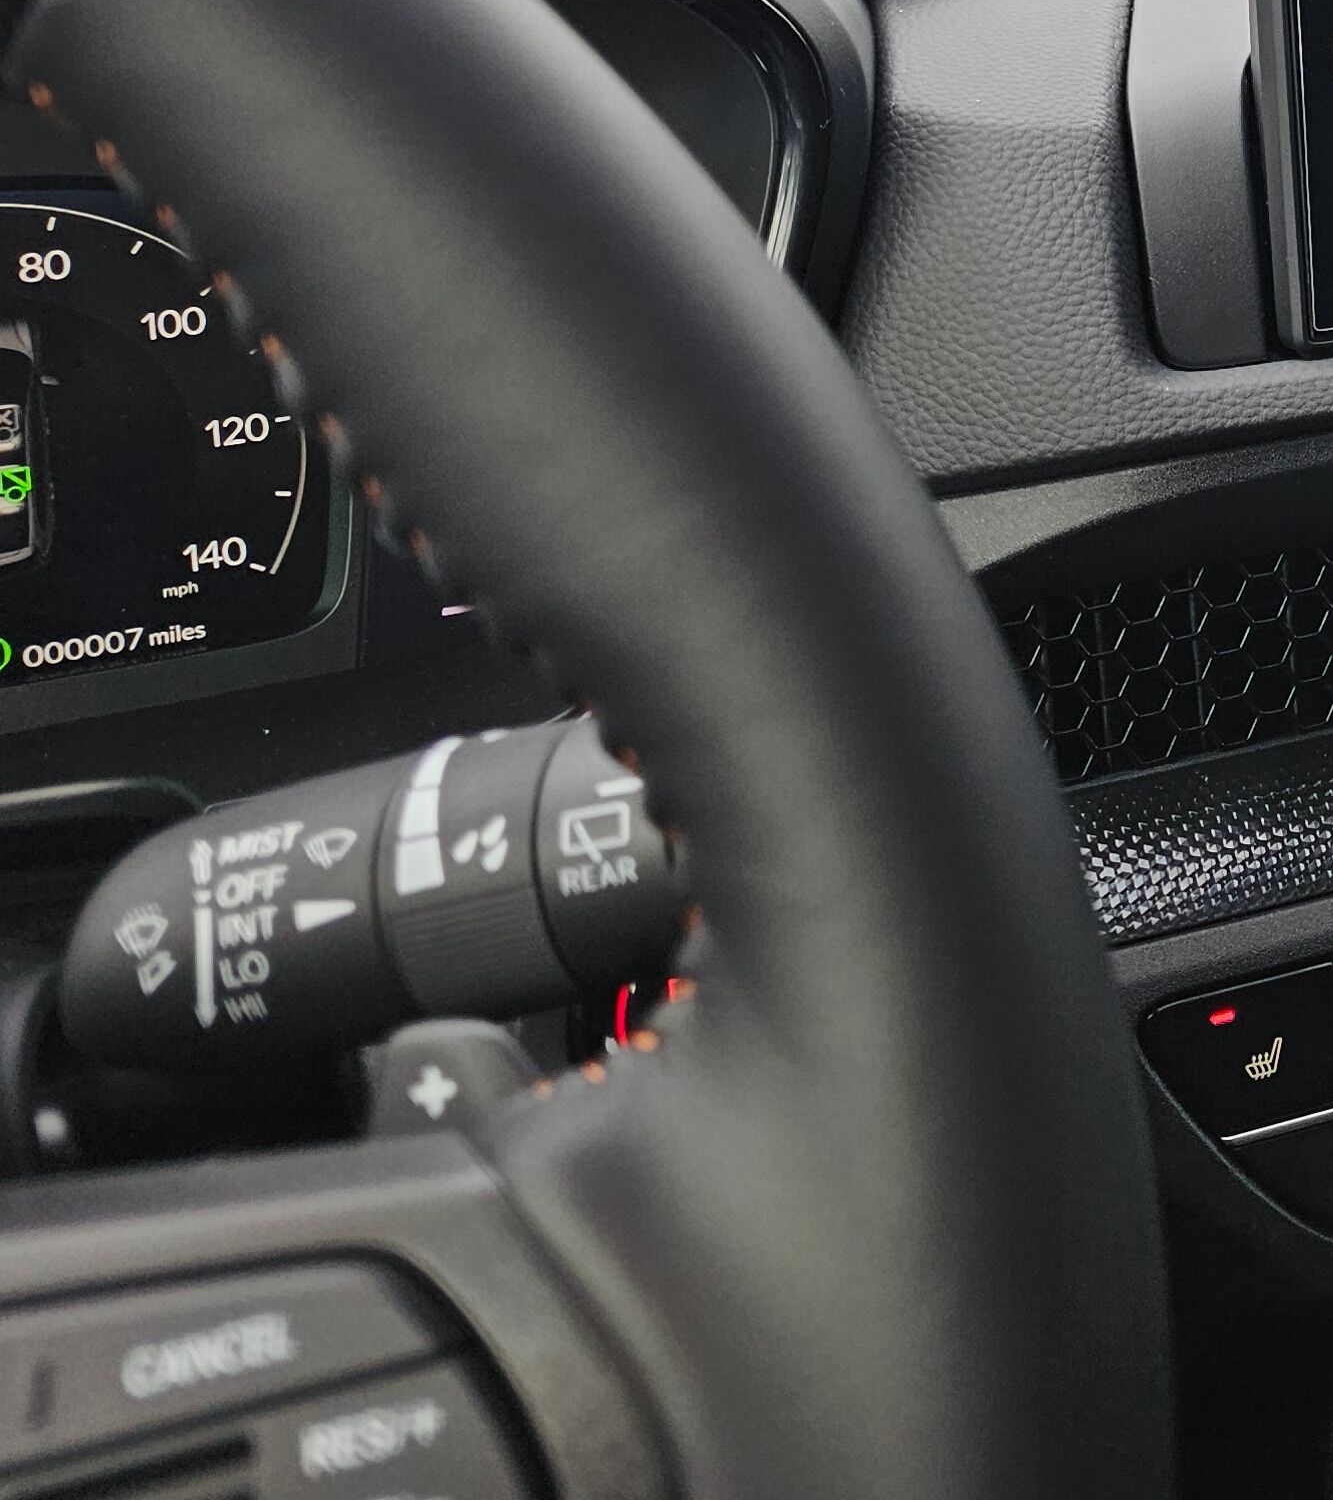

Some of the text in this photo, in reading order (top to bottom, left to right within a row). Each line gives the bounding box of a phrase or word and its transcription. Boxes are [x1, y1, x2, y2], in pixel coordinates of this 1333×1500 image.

[19, 250, 70, 282] 80
[141, 307, 206, 340] 100
[205, 413, 269, 447] 120
[183, 537, 246, 572] 140
[163, 582, 198, 598] mph
[23, 625, 206, 667] 000007 miles
[217, 821, 304, 866] MIST
[215, 864, 288, 909] OFF
[557, 856, 639, 898] REAR
[219, 950, 270, 988] LO
